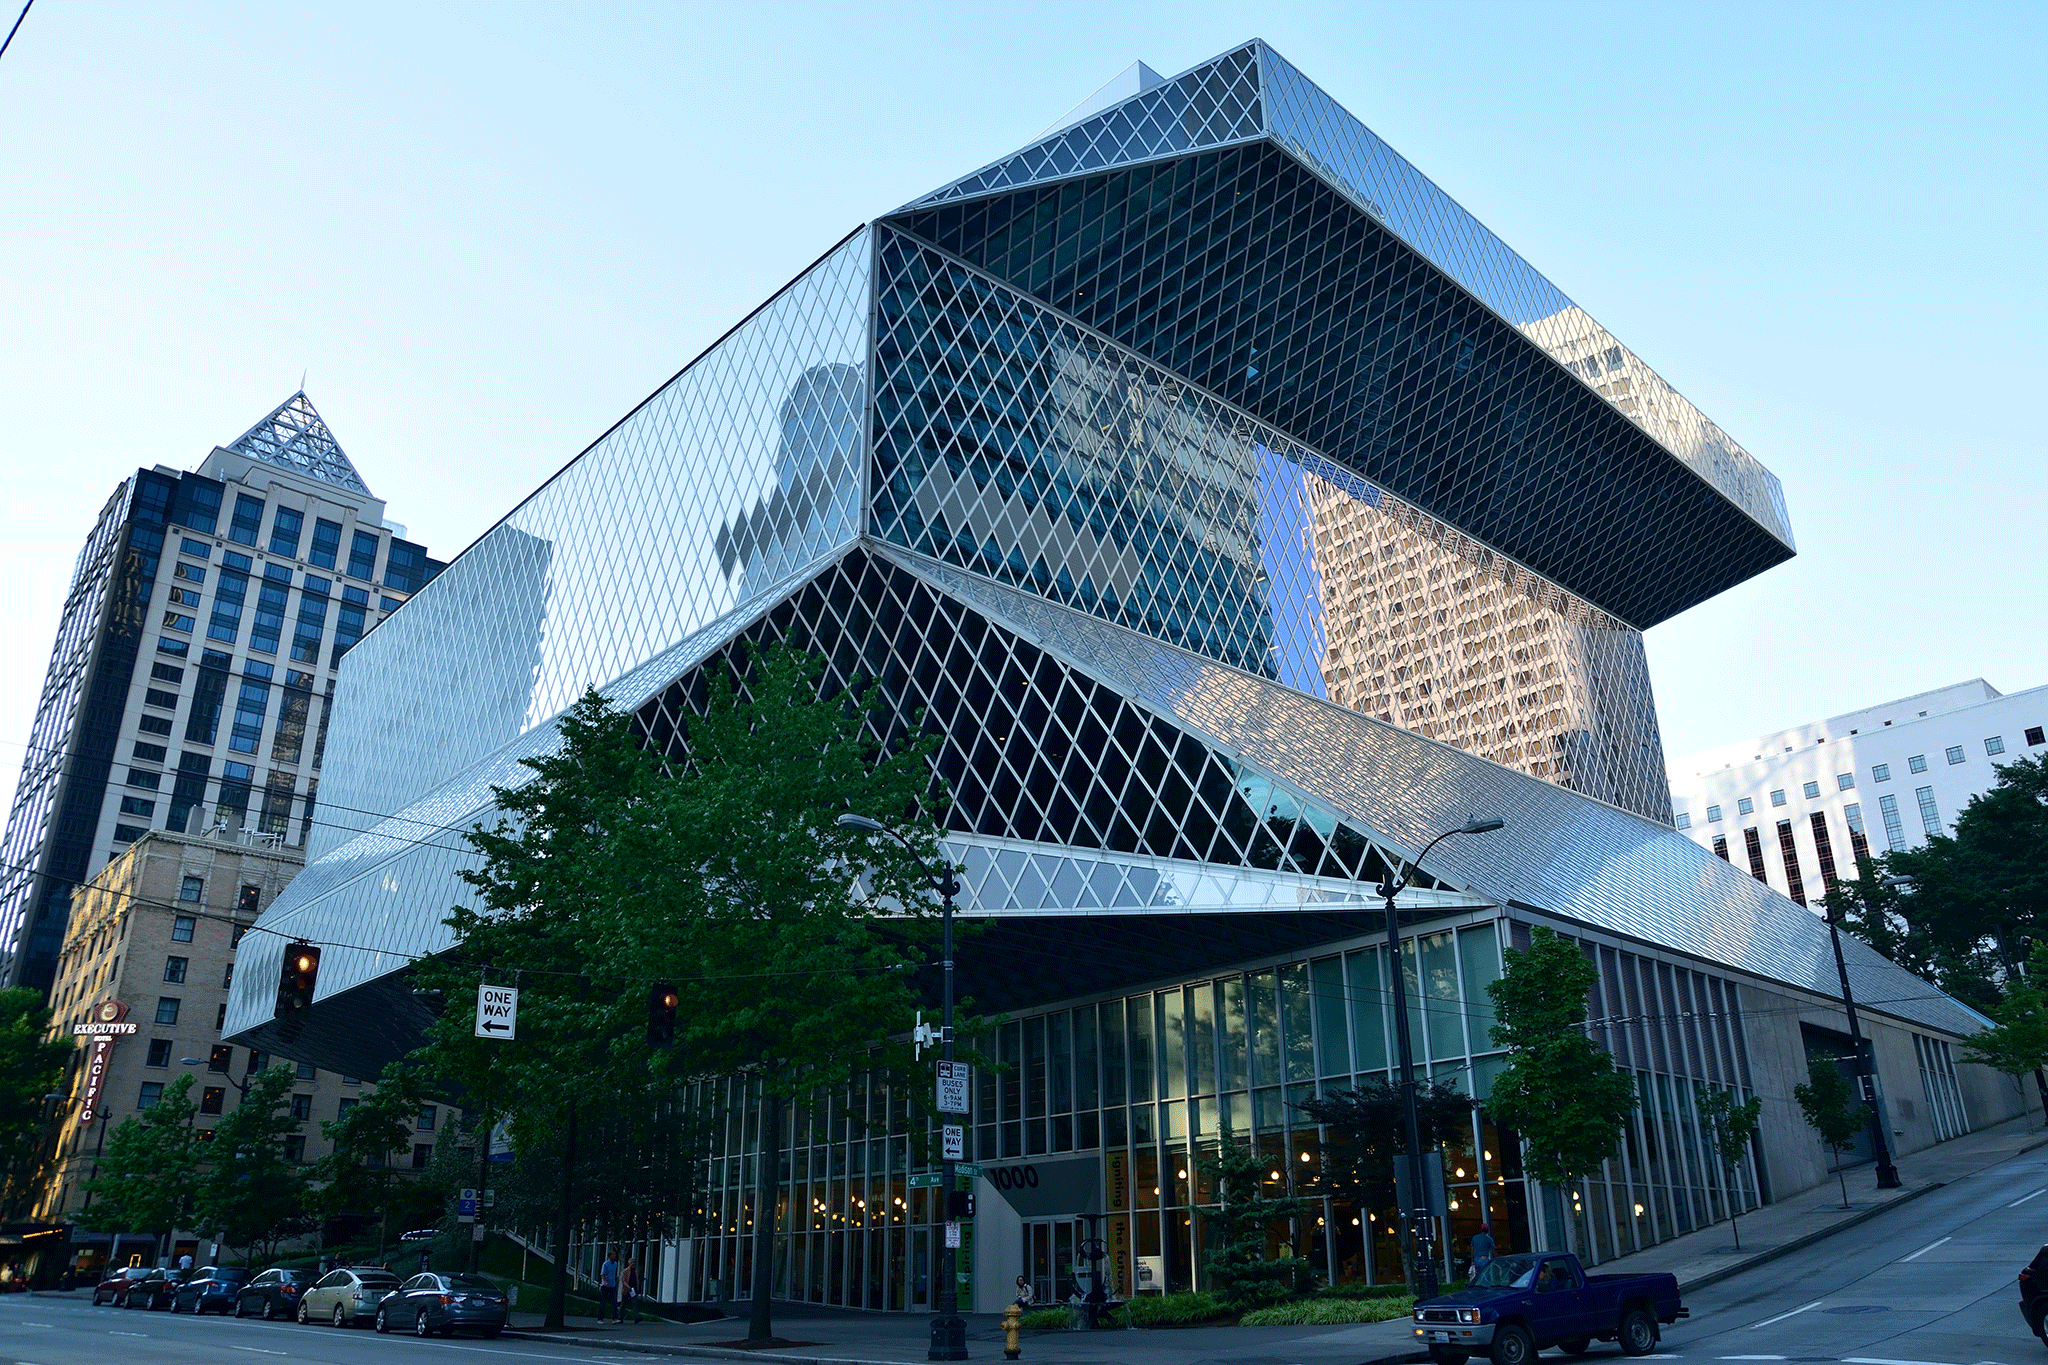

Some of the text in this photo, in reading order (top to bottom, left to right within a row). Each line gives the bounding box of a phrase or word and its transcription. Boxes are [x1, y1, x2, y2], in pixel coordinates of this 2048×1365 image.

[484, 991, 512, 1004] ONE
[484, 1004, 511, 1018] WAY
[73, 1023, 137, 1035] EXECUTIVE
[82, 1042, 106, 1120] PACIFIC
[942, 1080, 963, 1088] BUSES
[944, 1087, 961, 1095] ONLY
[945, 1127, 961, 1137] ONE
[945, 1137, 961, 1146] WAY
[954, 1163, 973, 1175] Madison
[930, 1175, 940, 1184] Ave
[989, 1164, 1039, 1190] 1000
[464, 1200, 471, 1209] 2
[1112, 1156, 1126, 1295] igniting the future
